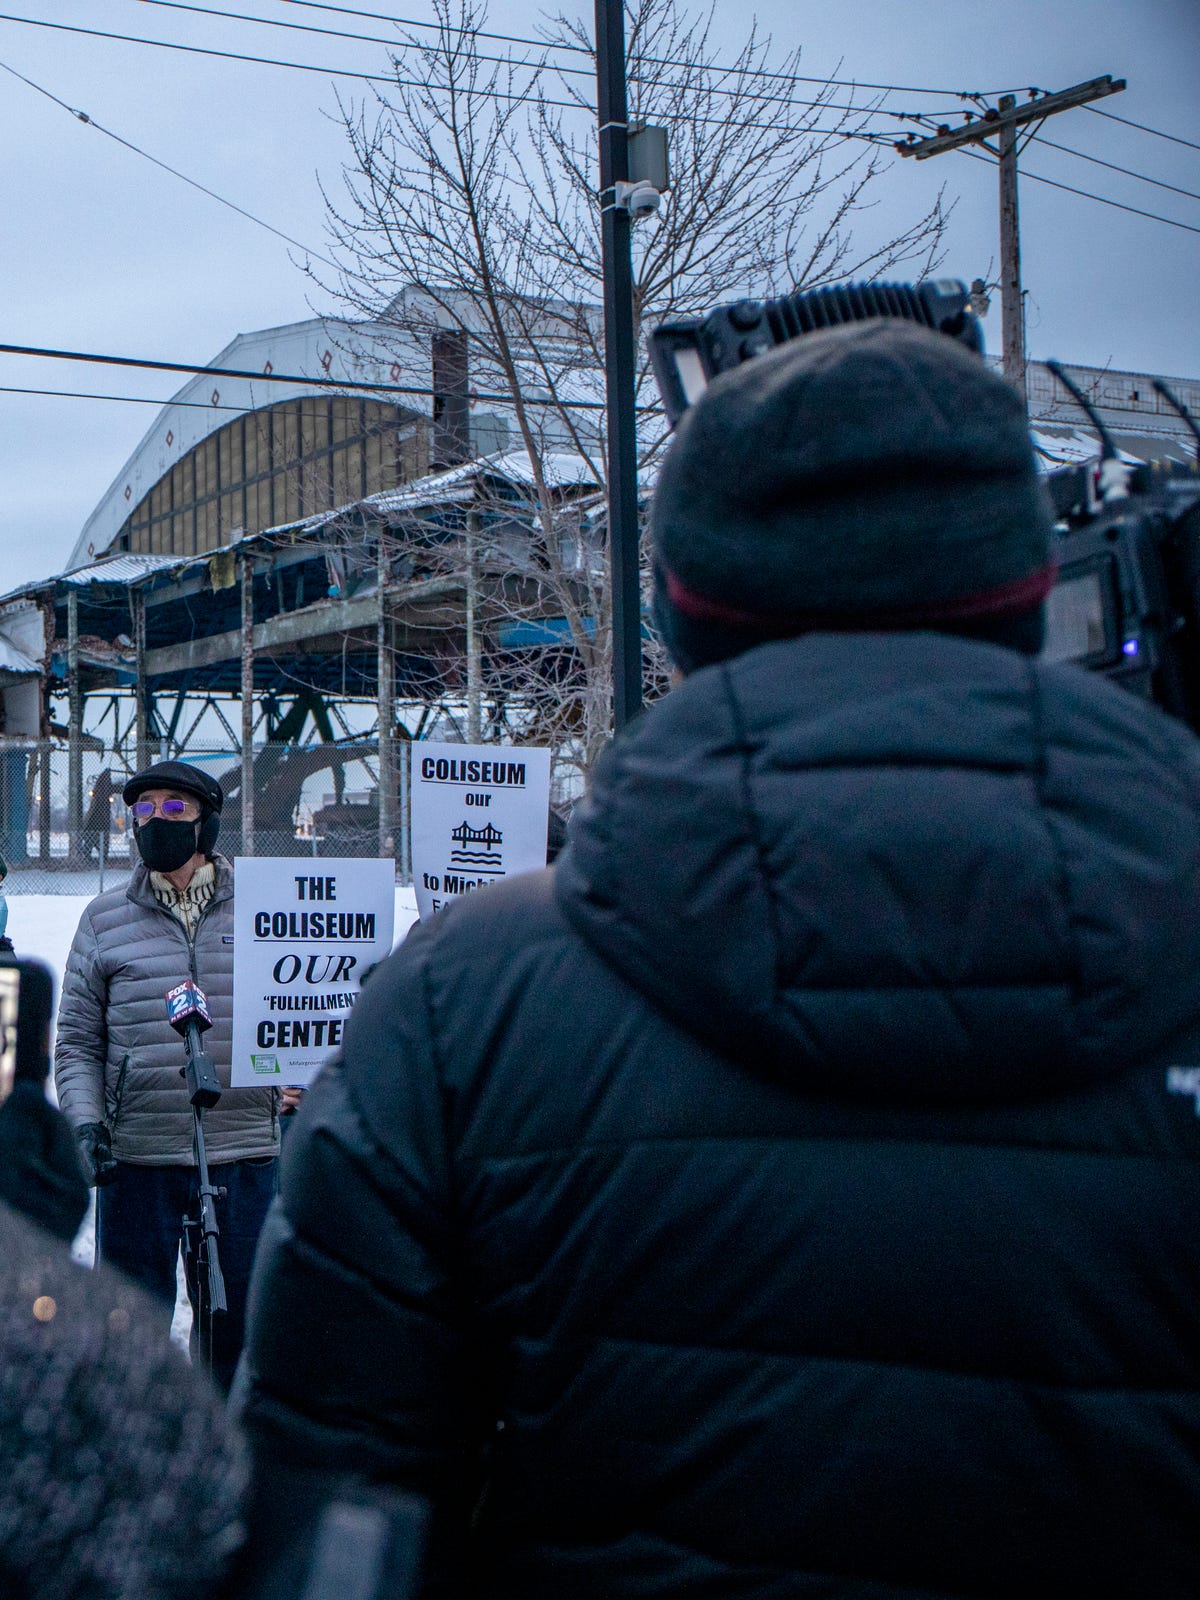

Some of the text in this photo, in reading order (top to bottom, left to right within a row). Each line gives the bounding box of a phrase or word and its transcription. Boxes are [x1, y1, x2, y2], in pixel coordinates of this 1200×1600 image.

[421, 757, 526, 785] COLISEUM
[465, 793, 492, 807] our
[294, 876, 337, 901] THE
[423, 873, 439, 891] to
[254, 911, 376, 939] COLISEUM
[272, 954, 357, 985] OUR
[168, 982, 188, 1000] FOX
[170, 1006, 194, 1023] NEWS
[172, 994, 189, 1014] 2
[256, 1019, 348, 1049] CENTE
